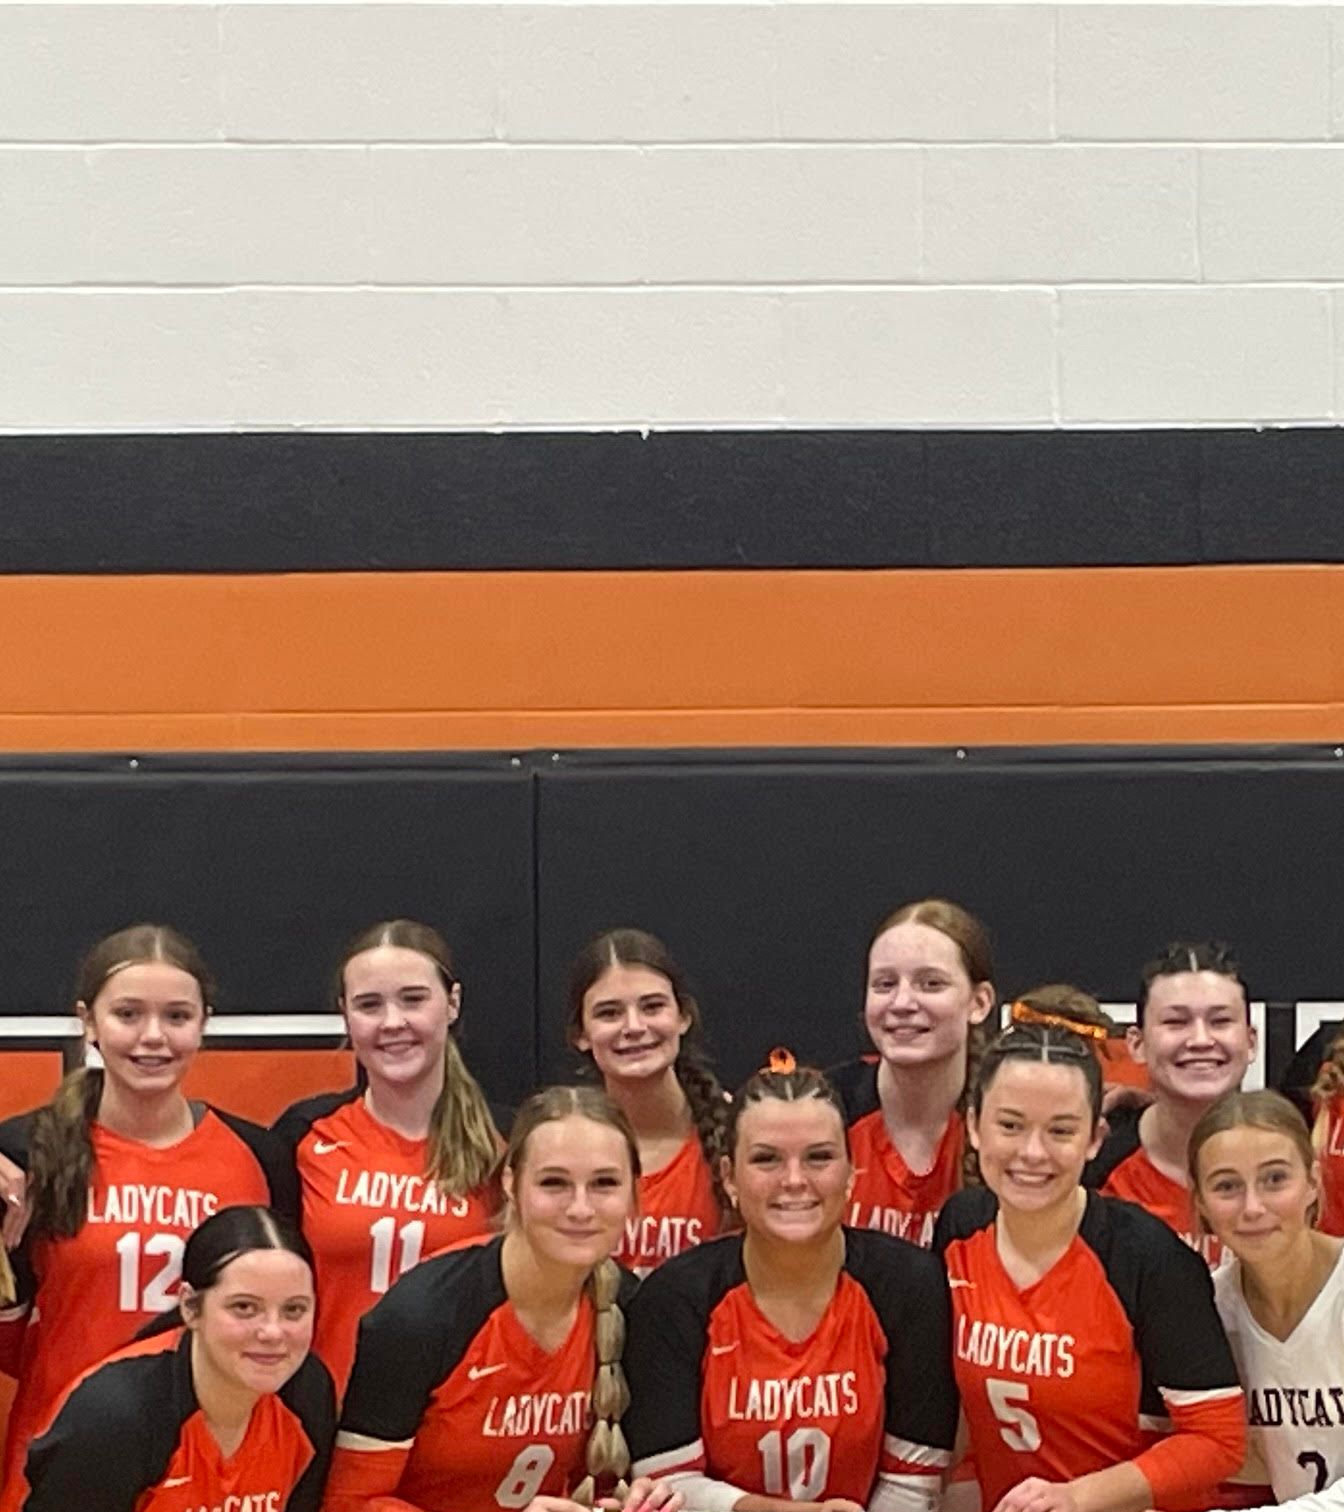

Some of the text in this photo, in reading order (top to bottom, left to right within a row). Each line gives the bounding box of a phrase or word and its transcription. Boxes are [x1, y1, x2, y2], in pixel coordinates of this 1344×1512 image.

[87, 1184, 219, 1229] LADYCATS
[116, 1231, 186, 1312] 12
[370, 1216, 426, 1294] 11
[957, 1313, 1076, 1378] LADYCATS
[728, 1371, 858, 1421] LADYCATS
[986, 1378, 1042, 1452] 5
[494, 1444, 556, 1508] 8
[757, 1427, 831, 1501] 10
